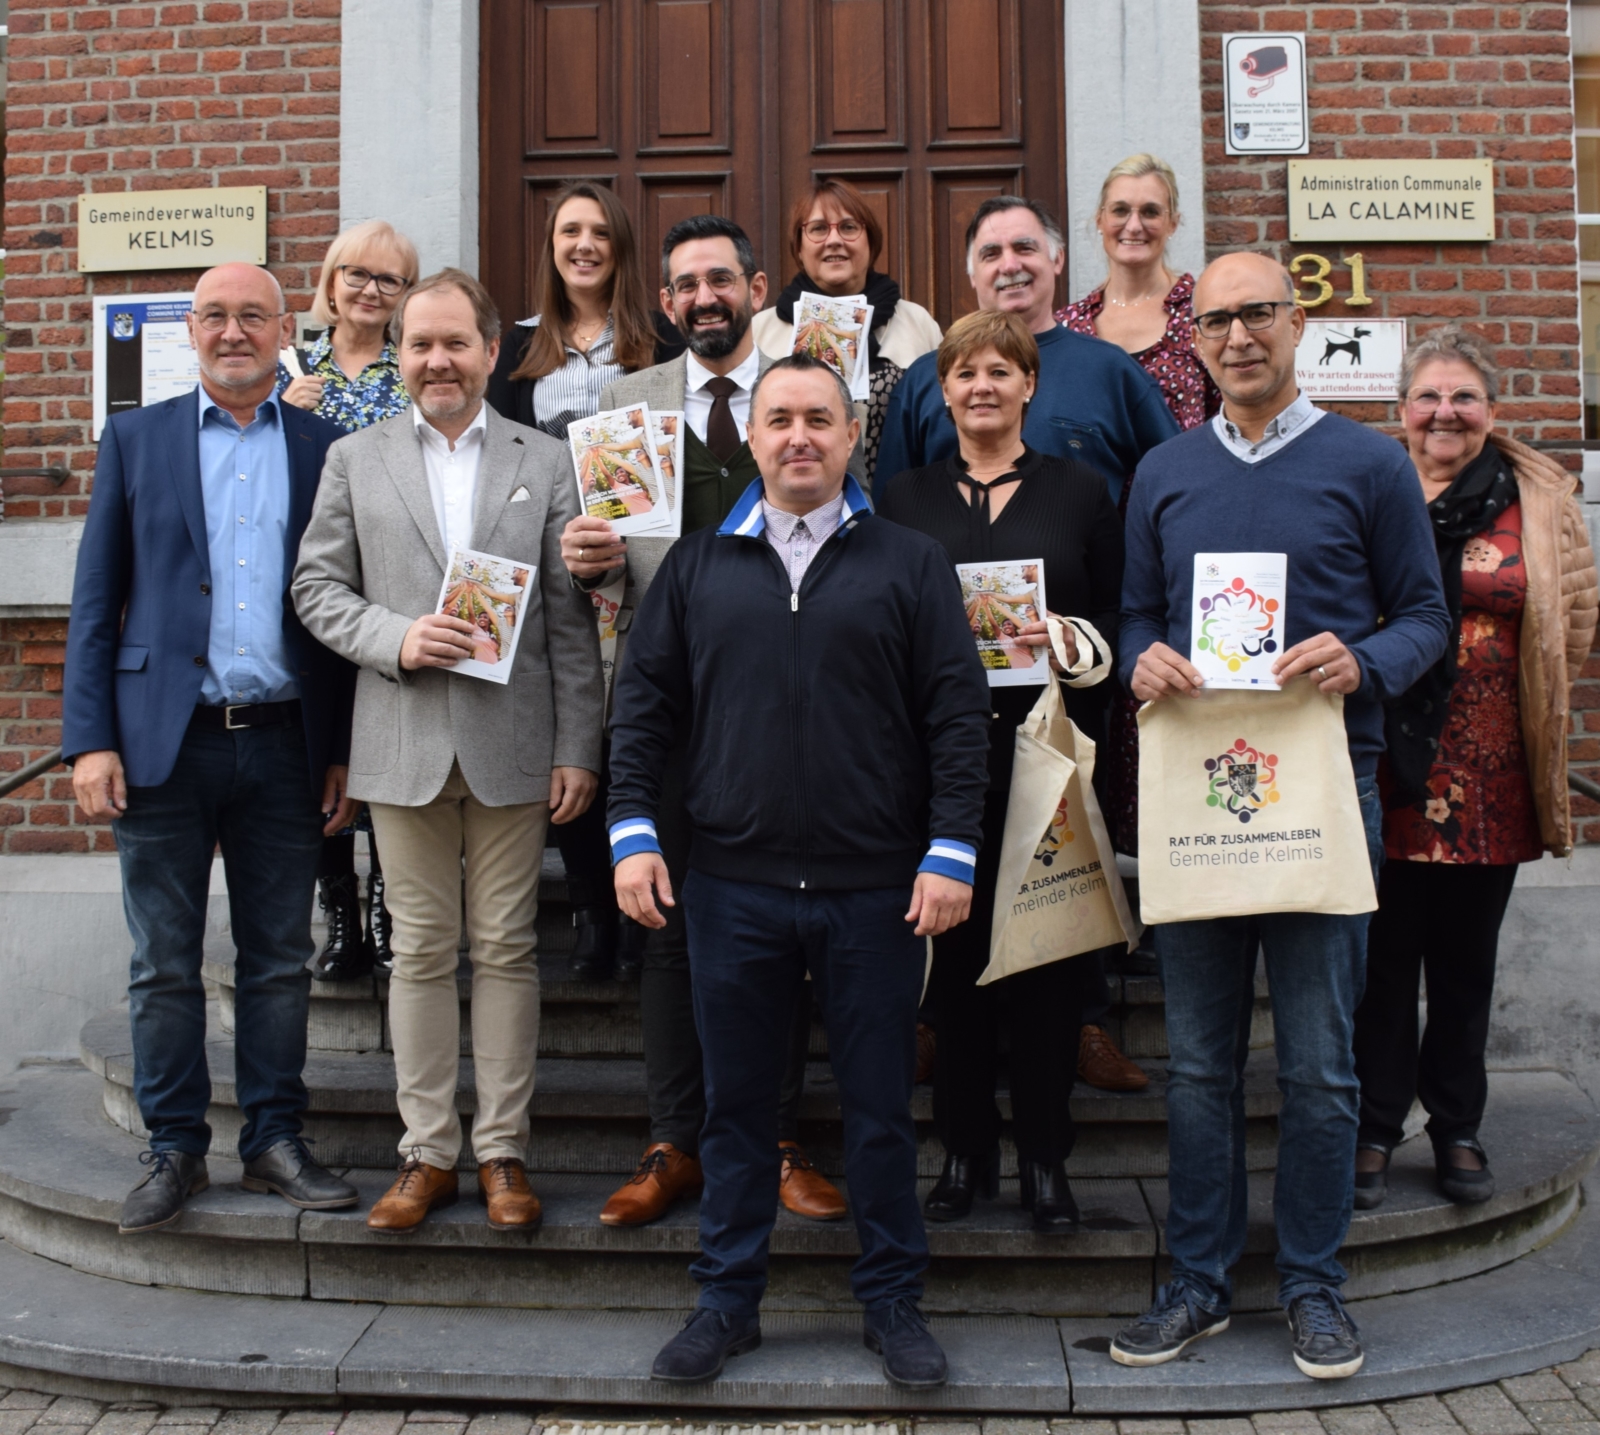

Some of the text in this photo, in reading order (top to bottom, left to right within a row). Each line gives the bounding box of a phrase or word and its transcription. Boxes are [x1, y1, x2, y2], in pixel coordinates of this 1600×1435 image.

[1300, 175, 1482, 192] Administration Communale
[89, 204, 255, 224] Gemeindeverwaltung
[1308, 202, 1476, 220] LA CALAMINE
[128, 229, 214, 250] KELMIS
[1290, 252, 1373, 308] 31
[1296, 369, 1395, 379] Wir warten draussen
[1301, 383, 1396, 392] ous attendons dehor
[1169, 828, 1321, 847] RAT FÜR ZUSAMMENLEBEN
[1169, 843, 1323, 867] Gemeinde Kelmis
[1031, 860, 1102, 891] ZUSAMMENLEB
[1011, 888, 1067, 917] meinde
[1069, 872, 1107, 898] Kelmi
